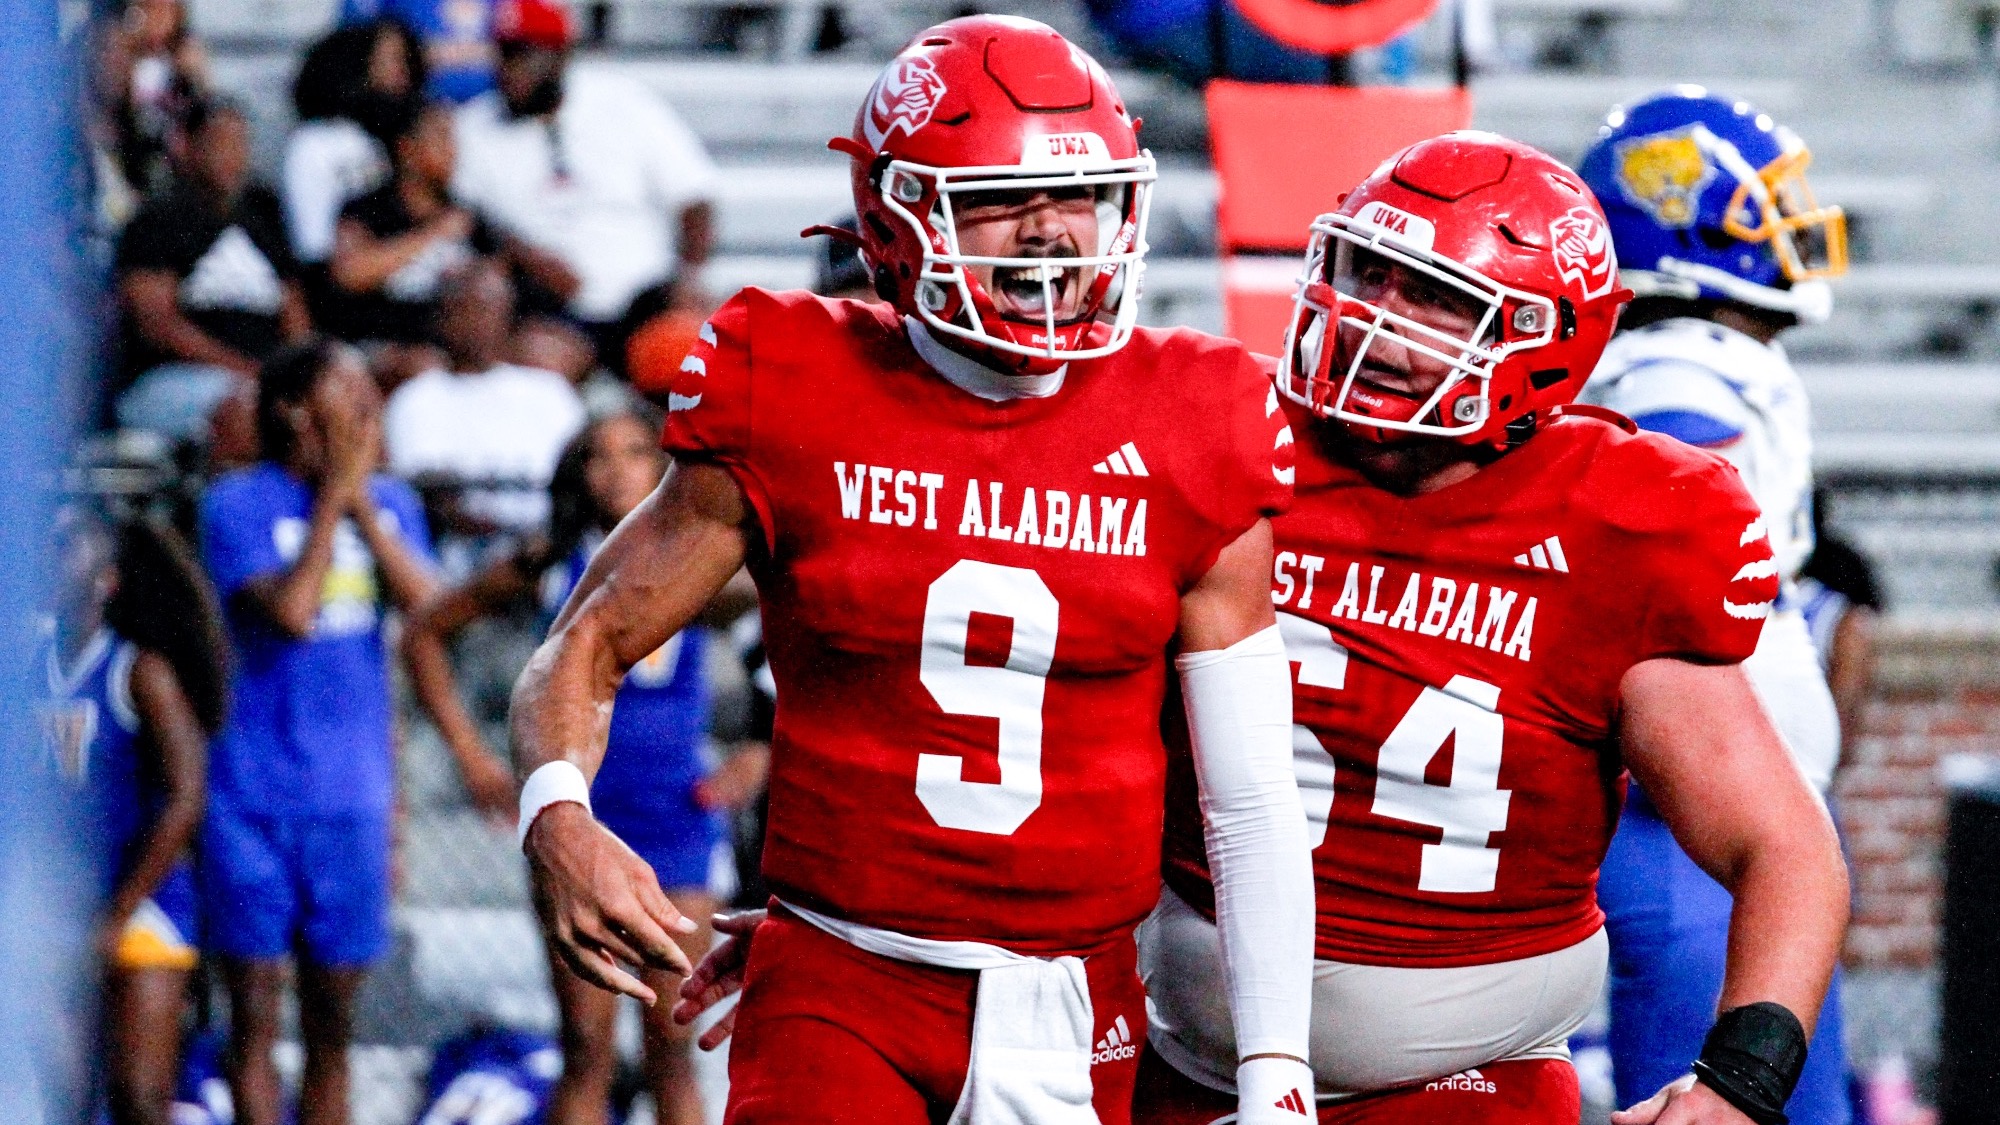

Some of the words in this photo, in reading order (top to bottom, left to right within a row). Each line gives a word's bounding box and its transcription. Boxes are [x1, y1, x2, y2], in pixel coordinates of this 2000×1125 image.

[1048, 137, 1089, 156] UWA
[1373, 207, 1408, 235] UWA
[1100, 220, 1136, 276] Rddell
[1351, 389, 1384, 408] Riddell
[833, 461, 945, 530] WEST
[958, 478, 1148, 556] ALABAMA
[1271, 550, 1325, 610] ST
[1331, 561, 1539, 662] ALABAMA
[915, 558, 1060, 836] 9
[1090, 1042, 1136, 1065] adidas
[1425, 1076, 1497, 1094] adidas
